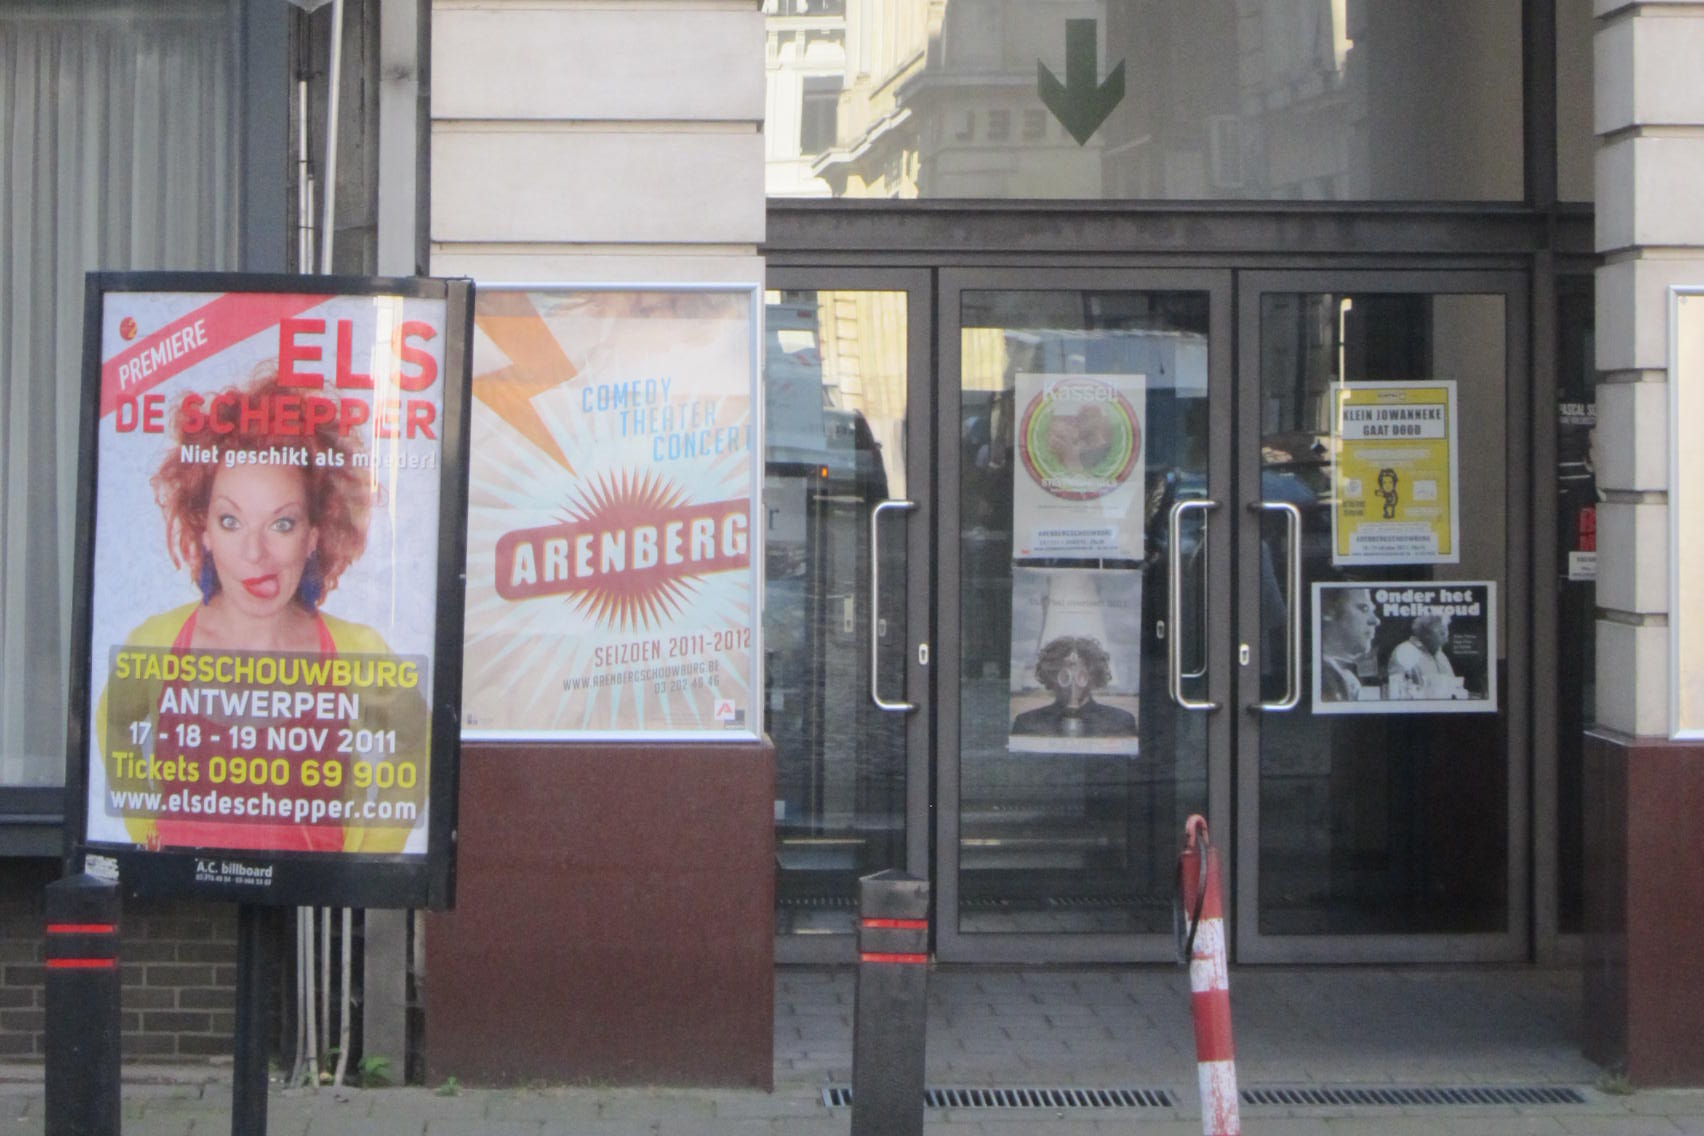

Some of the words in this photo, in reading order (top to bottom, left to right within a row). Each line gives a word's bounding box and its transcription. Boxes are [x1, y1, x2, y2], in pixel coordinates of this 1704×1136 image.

[118, 318, 208, 391] PREMIERE
[278, 317, 438, 392] ELS
[582, 376, 671, 413] COMEDY
[115, 393, 165, 434] DE
[180, 393, 437, 440] SCHEPPER
[620, 400, 716, 437] THEATER
[1344, 409, 1373, 421] KLEIN
[1376, 408, 1441, 421] JOWANNEKE
[1363, 425, 1389, 436] GAAT
[1392, 424, 1422, 436] DOOD
[181, 445, 219, 463] Niet
[225, 447, 308, 468] geschikt
[315, 448, 344, 467] als
[511, 512, 748, 587] ARENBERG
[1375, 589, 1435, 604] Onder
[1440, 589, 1472, 603] het
[1383, 603, 1480, 617] Melkwoud
[594, 640, 661, 668] SEIZOEN
[669, 627, 750, 658] 2011-2012
[115, 652, 418, 689] STADSSCHOUWBURG
[159, 687, 360, 721] ANTWERPEN
[129, 721, 152, 745] 17
[175, 723, 201, 748] 18
[228, 725, 257, 750] 19
[266, 727, 329, 752] NOV
[336, 729, 397, 754] 2011
[111, 751, 200, 783] Tickets
[208, 756, 290, 785] 0900
[300, 760, 343, 788] 69
[353, 761, 417, 790] 900
[110, 789, 417, 824] www.elsdeschepper.com
[220, 863, 274, 879] billboard
